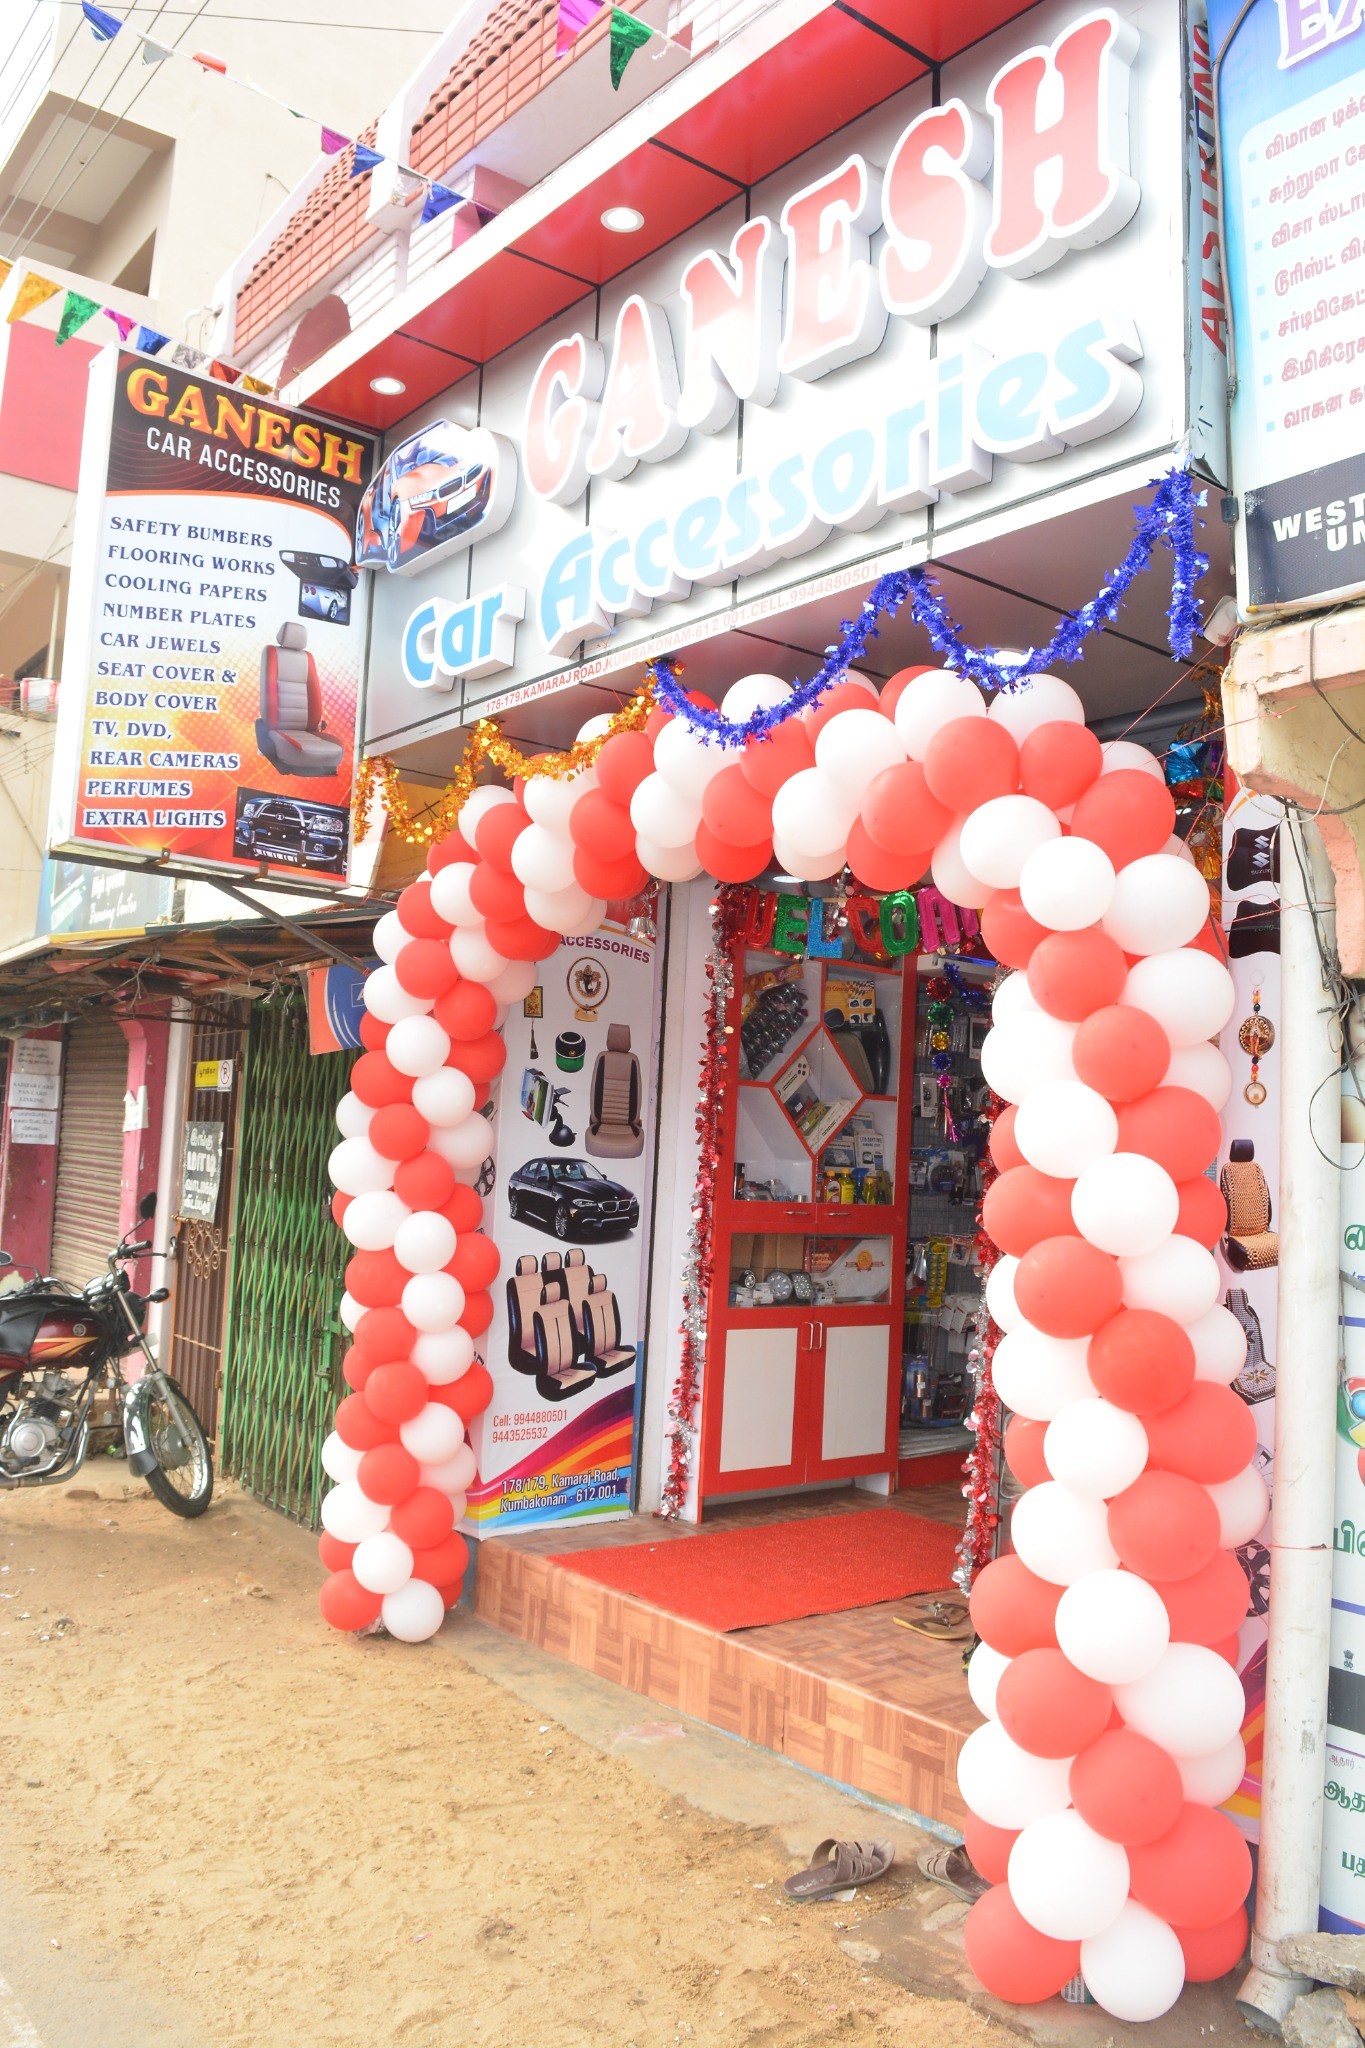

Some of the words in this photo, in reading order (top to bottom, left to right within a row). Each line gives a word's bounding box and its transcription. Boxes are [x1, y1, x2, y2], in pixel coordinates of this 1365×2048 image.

[1266, 116, 1326, 160] விமான
[1269, 156, 1339, 204] சுற்றுலா
[1272, 216, 1313, 248] விசா
[1319, 192, 1365, 226] ஸ்டா
[522, 8, 1119, 503] GANESH
[1275, 254, 1336, 296] டூரிஸ்ட்
[1341, 237, 1365, 264] வி
[1284, 393, 1343, 429] வாகன
[126, 367, 365, 484] GANESH
[146, 426, 191, 460] CAR
[199, 444, 341, 508] ACCESSORIES
[538, 314, 1118, 656] Accessories
[110, 516, 181, 538] SAFETY
[187, 525, 273, 548] BUMBERS
[108, 545, 204, 568] FLOORING
[212, 556, 275, 576] WORKS
[105, 573, 192, 595] COOLING
[199, 582, 268, 602] PAPERS
[103, 603, 183, 622] NUMBER
[190, 611, 256, 629] PLATES
[100, 632, 139, 647] CAR
[146, 636, 221, 654] JEWELS
[402, 586, 508, 690] Car
[97, 661, 146, 678] SEAT
[152, 665, 215, 682] COVER
[221, 669, 237, 683] &
[95, 691, 149, 707] BODY
[154, 694, 217, 711] COVER
[92, 721, 119, 738] TV,
[127, 722, 173, 740] DVD,
[90, 751, 142, 766] REAR
[149, 752, 239, 769] CAMERAS
[87, 780, 191, 797] PERFUMES
[84, 810, 148, 826] EXTRA
[154, 811, 225, 827] LIGHTS
[559, 936, 650, 964] ACCESSORIES
[493, 1415, 511, 1428] Cell:
[514, 1410, 567, 1425] 9944880501
[492, 1427, 547, 1443] 9443525532
[502, 1475, 549, 1494] 178/179,
[552, 1470, 592, 1488] Kamaraj
[594, 1467, 620, 1482] Road,
[500, 1493, 567, 1513] Kumbakonam
[576, 1488, 595, 1503] 612
[598, 1485, 620, 1499] 001.
